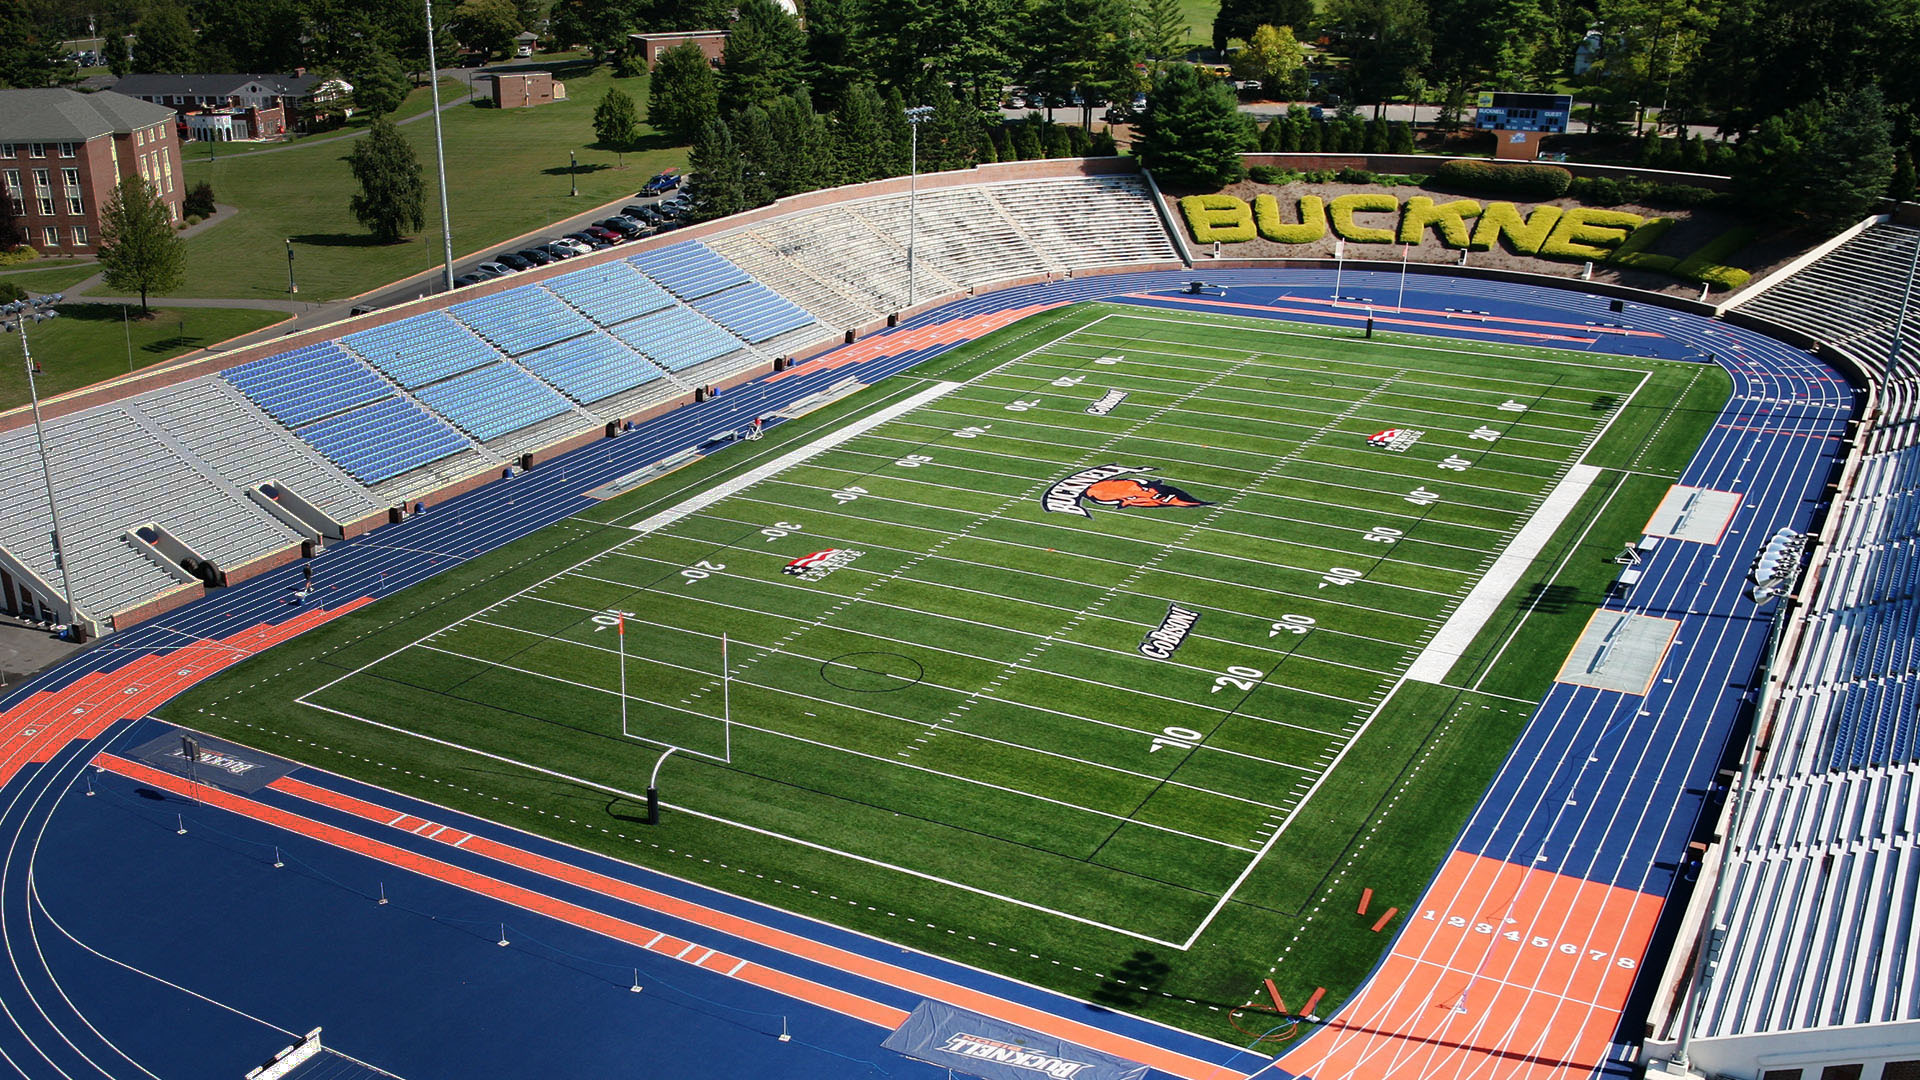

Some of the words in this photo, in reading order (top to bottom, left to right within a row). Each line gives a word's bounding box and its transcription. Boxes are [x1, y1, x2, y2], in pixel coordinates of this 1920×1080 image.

[1051, 376, 1083, 388] 20
[1004, 400, 1037, 412] 30
[1496, 402, 1528, 412] 10
[952, 426, 986, 439] 40
[1467, 428, 1501, 442] 20
[894, 454, 934, 468] 50
[1437, 458, 1472, 472] 30
[831, 486, 869, 501] 40
[1403, 490, 1440, 506] 40
[760, 521, 802, 538] 30
[1362, 526, 1404, 544] 50
[680, 560, 726, 579] 20
[1322, 567, 1363, 586] 40
[591, 609, 636, 626] 10
[1271, 613, 1316, 634] 30
[1215, 665, 1264, 691] 20
[1152, 726, 1202, 749] 10
[1423, 910, 1435, 921] 1
[1448, 915, 1466, 928] 2
[1475, 922, 1494, 935] 3
[1503, 929, 1520, 942] 4
[1531, 936, 1549, 949] 5
[1560, 943, 1577, 955] 6
[1589, 949, 1608, 961] 7
[1617, 957, 1636, 970] 8
[948, 1037, 1081, 1079] BUCKNELL
